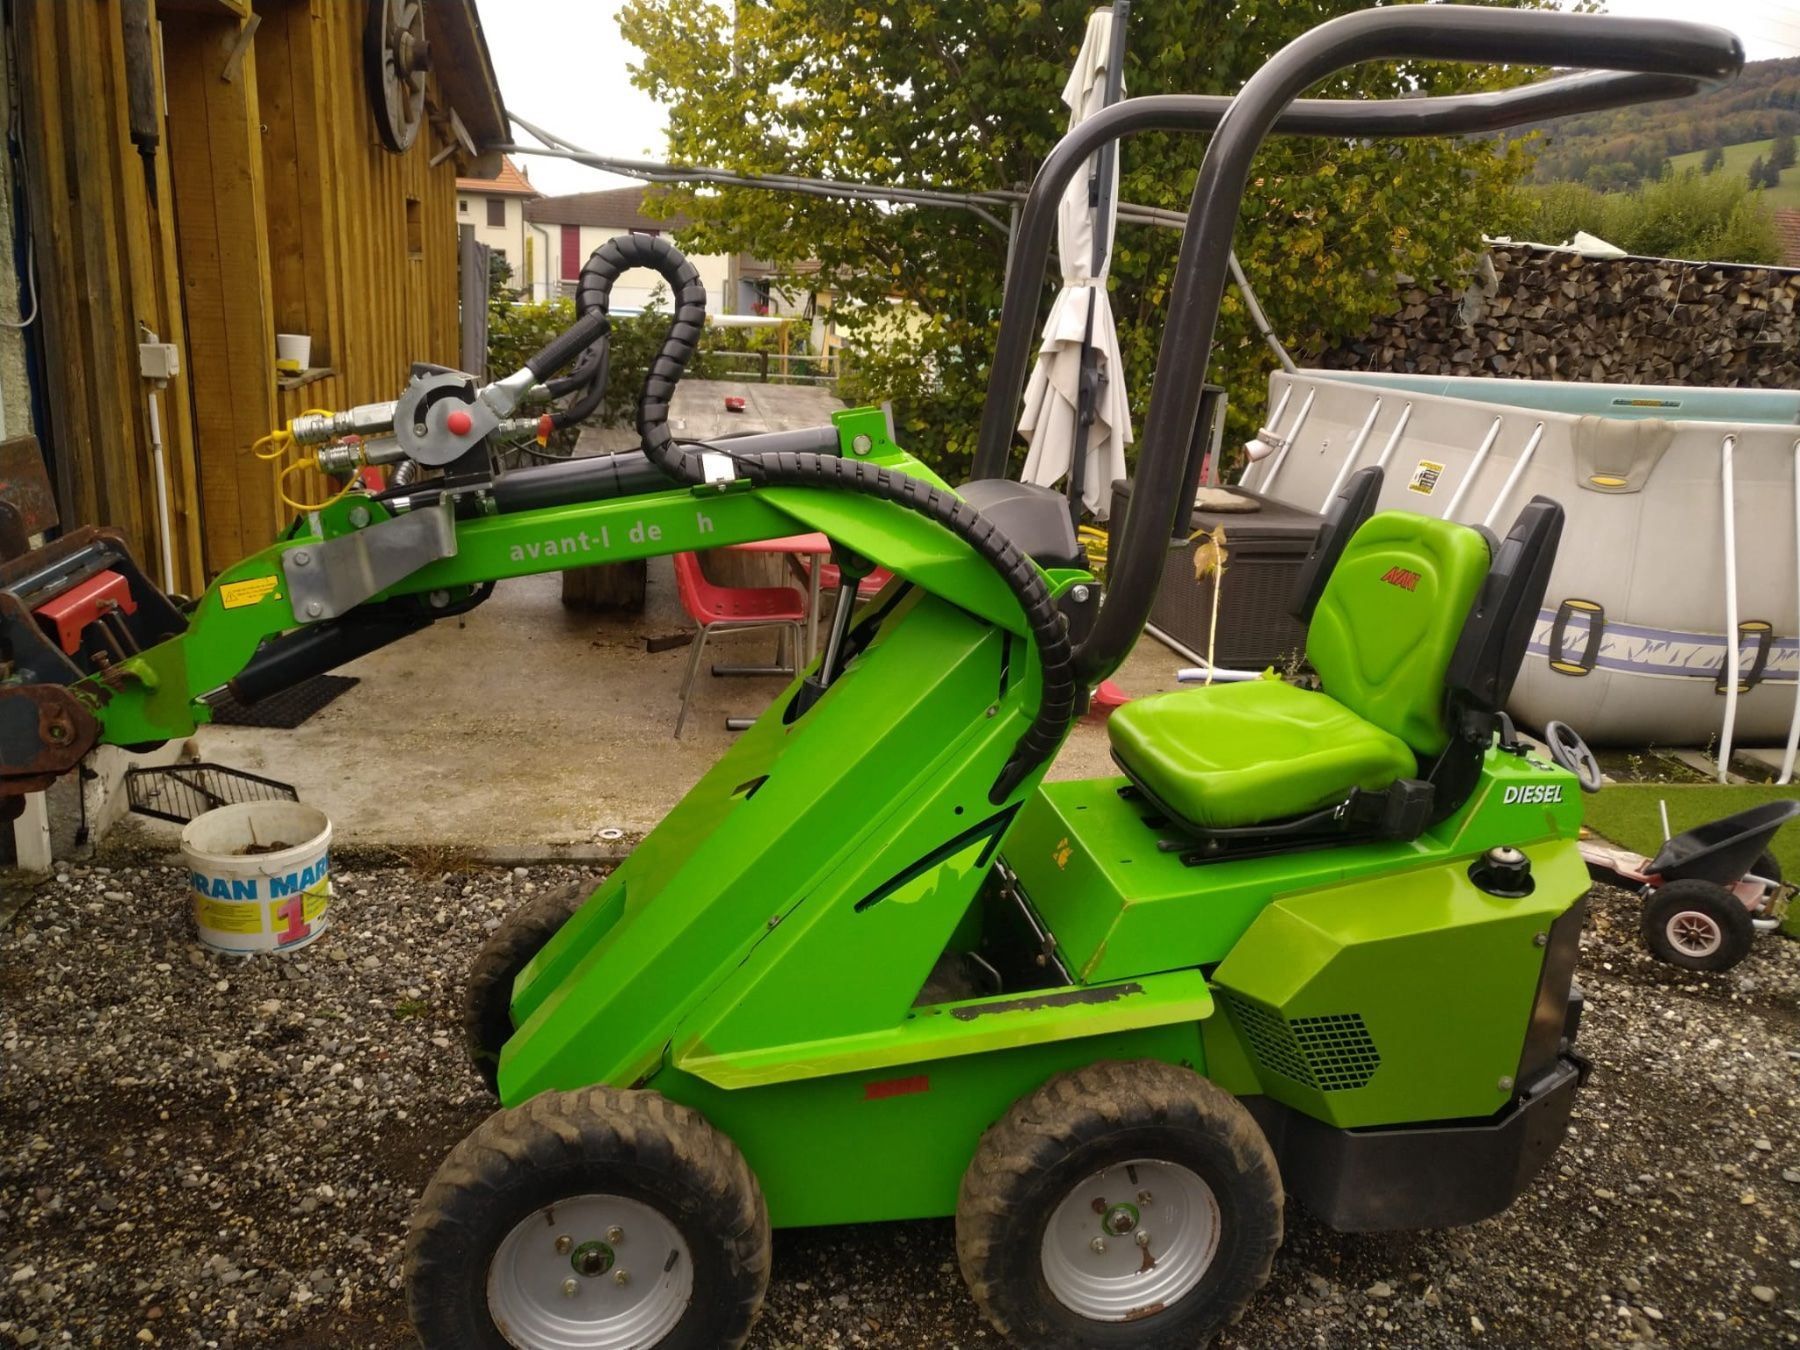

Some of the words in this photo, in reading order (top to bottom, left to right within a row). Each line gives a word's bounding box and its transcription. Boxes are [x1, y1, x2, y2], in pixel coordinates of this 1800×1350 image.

[629, 520, 663, 544] de
[696, 511, 714, 534] h
[1503, 784, 1563, 804] DIESEL
[277, 894, 311, 946] 1
